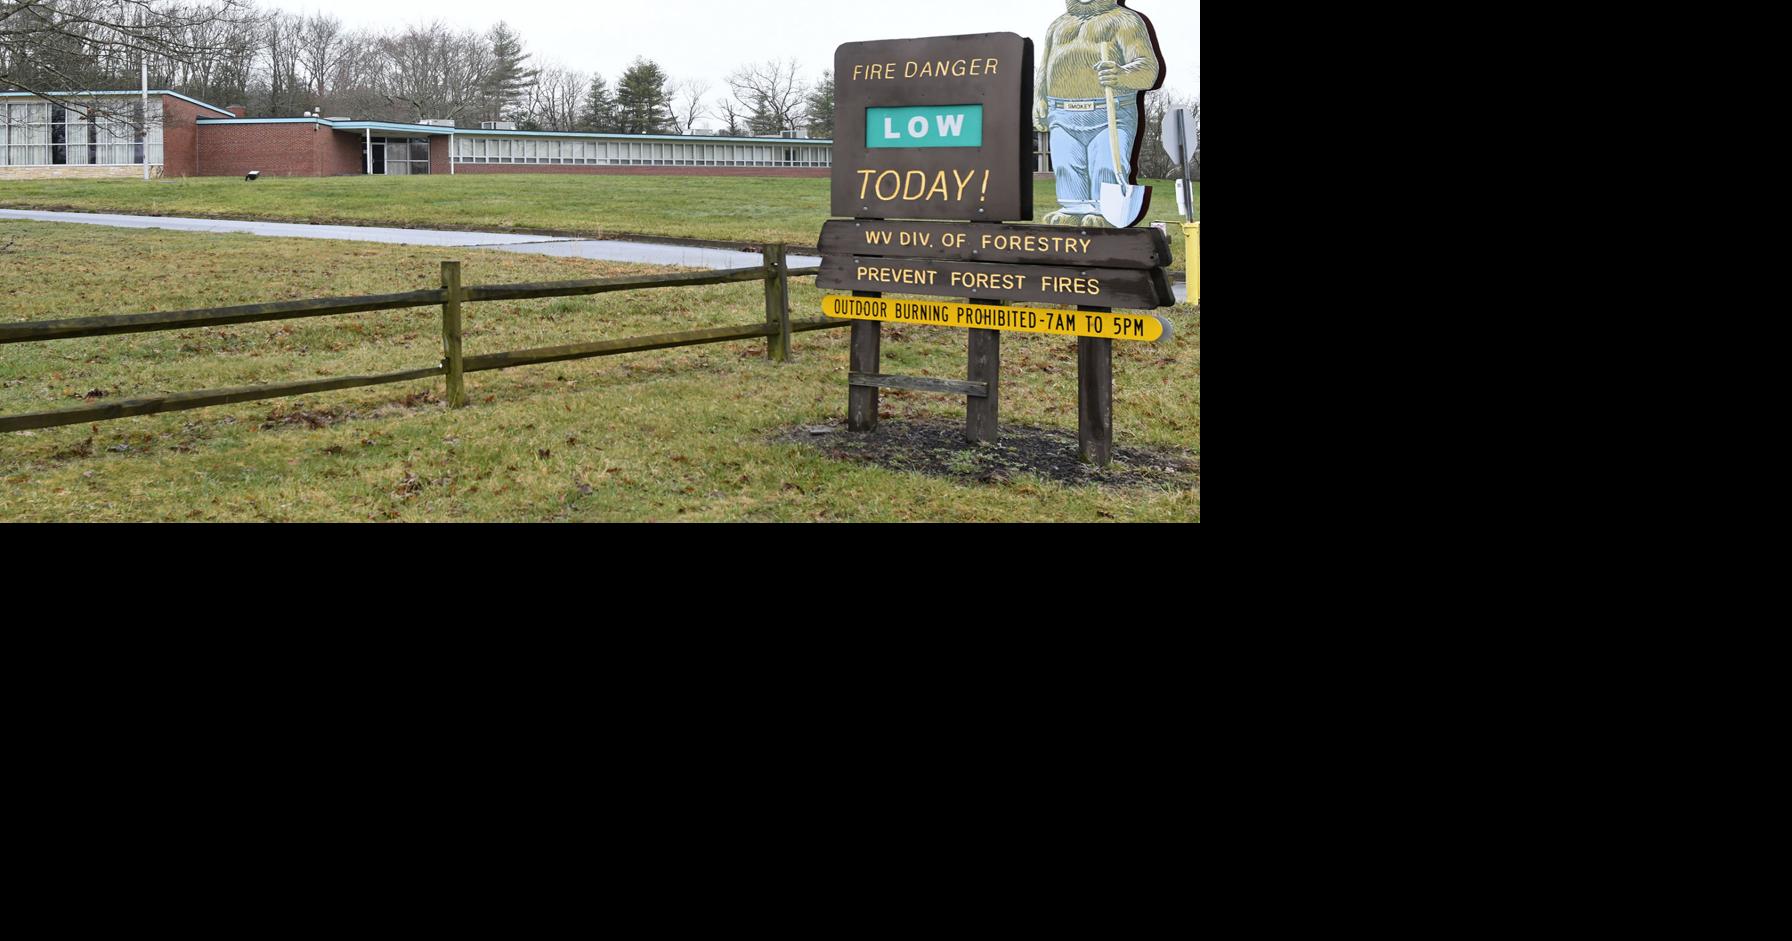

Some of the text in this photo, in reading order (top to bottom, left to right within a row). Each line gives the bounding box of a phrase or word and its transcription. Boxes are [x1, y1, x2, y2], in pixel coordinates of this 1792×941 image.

[853, 58, 999, 81] FIRE DANGER
[884, 114, 964, 139] LOW
[857, 169, 990, 202] TODAY!
[865, 230, 1091, 253] WV DIV. OF FORESTRY
[857, 266, 1100, 295] PREVENT FOREST FIRES
[834, 299, 888, 318] OUTDOOR
[895, 303, 949, 322] BURNING
[1086, 315, 1103, 334] TO
[1113, 317, 1145, 337] 5PM
